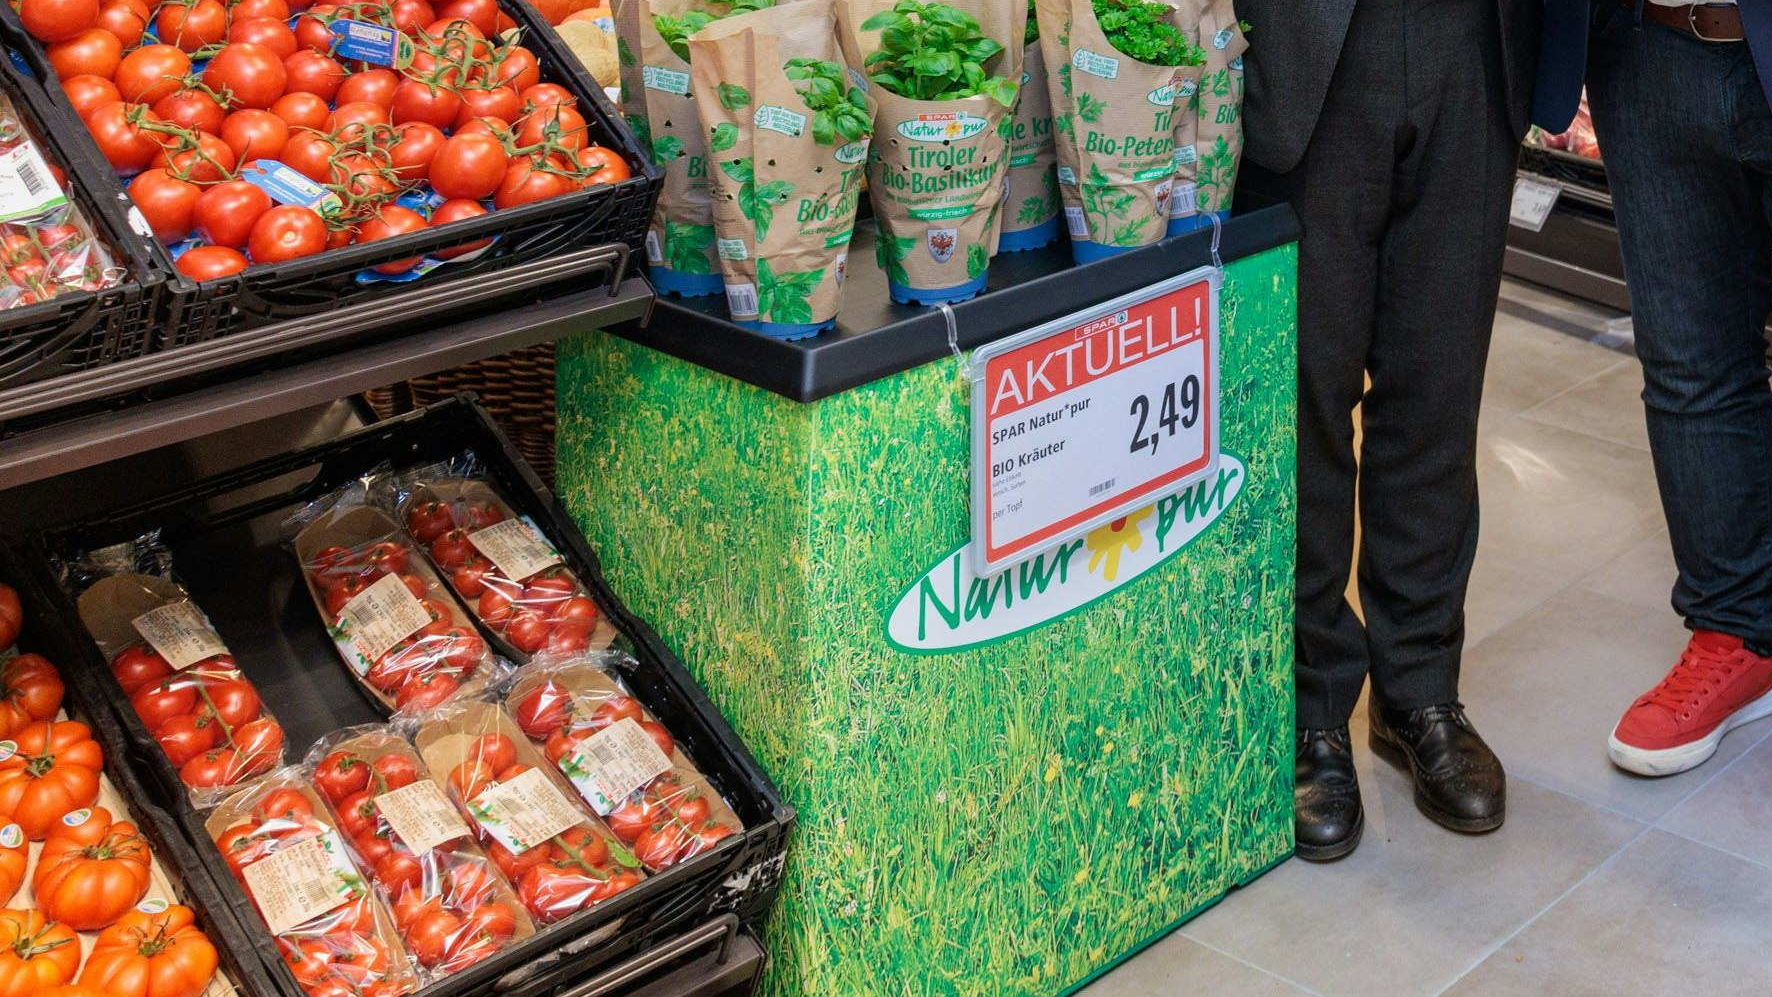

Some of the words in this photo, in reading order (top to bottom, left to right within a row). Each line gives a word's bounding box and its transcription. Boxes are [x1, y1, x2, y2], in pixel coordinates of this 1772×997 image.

[902, 122, 944, 136] Natur
[963, 121, 986, 136] pur
[908, 146, 977, 169] Tiroler
[916, 208, 968, 218] würzig-frisch
[1084, 317, 1117, 335] SPAR
[990, 297, 1201, 415] AKTUELL!
[1129, 374, 1200, 456] 2,49
[992, 421, 1026, 445] SPAR
[992, 458, 1014, 478] BIO
[1018, 438, 1065, 467] Kräuter
[992, 508, 1006, 521] per
[1007, 498, 1023, 515] Topf
[1155, 468, 1239, 553] pur
